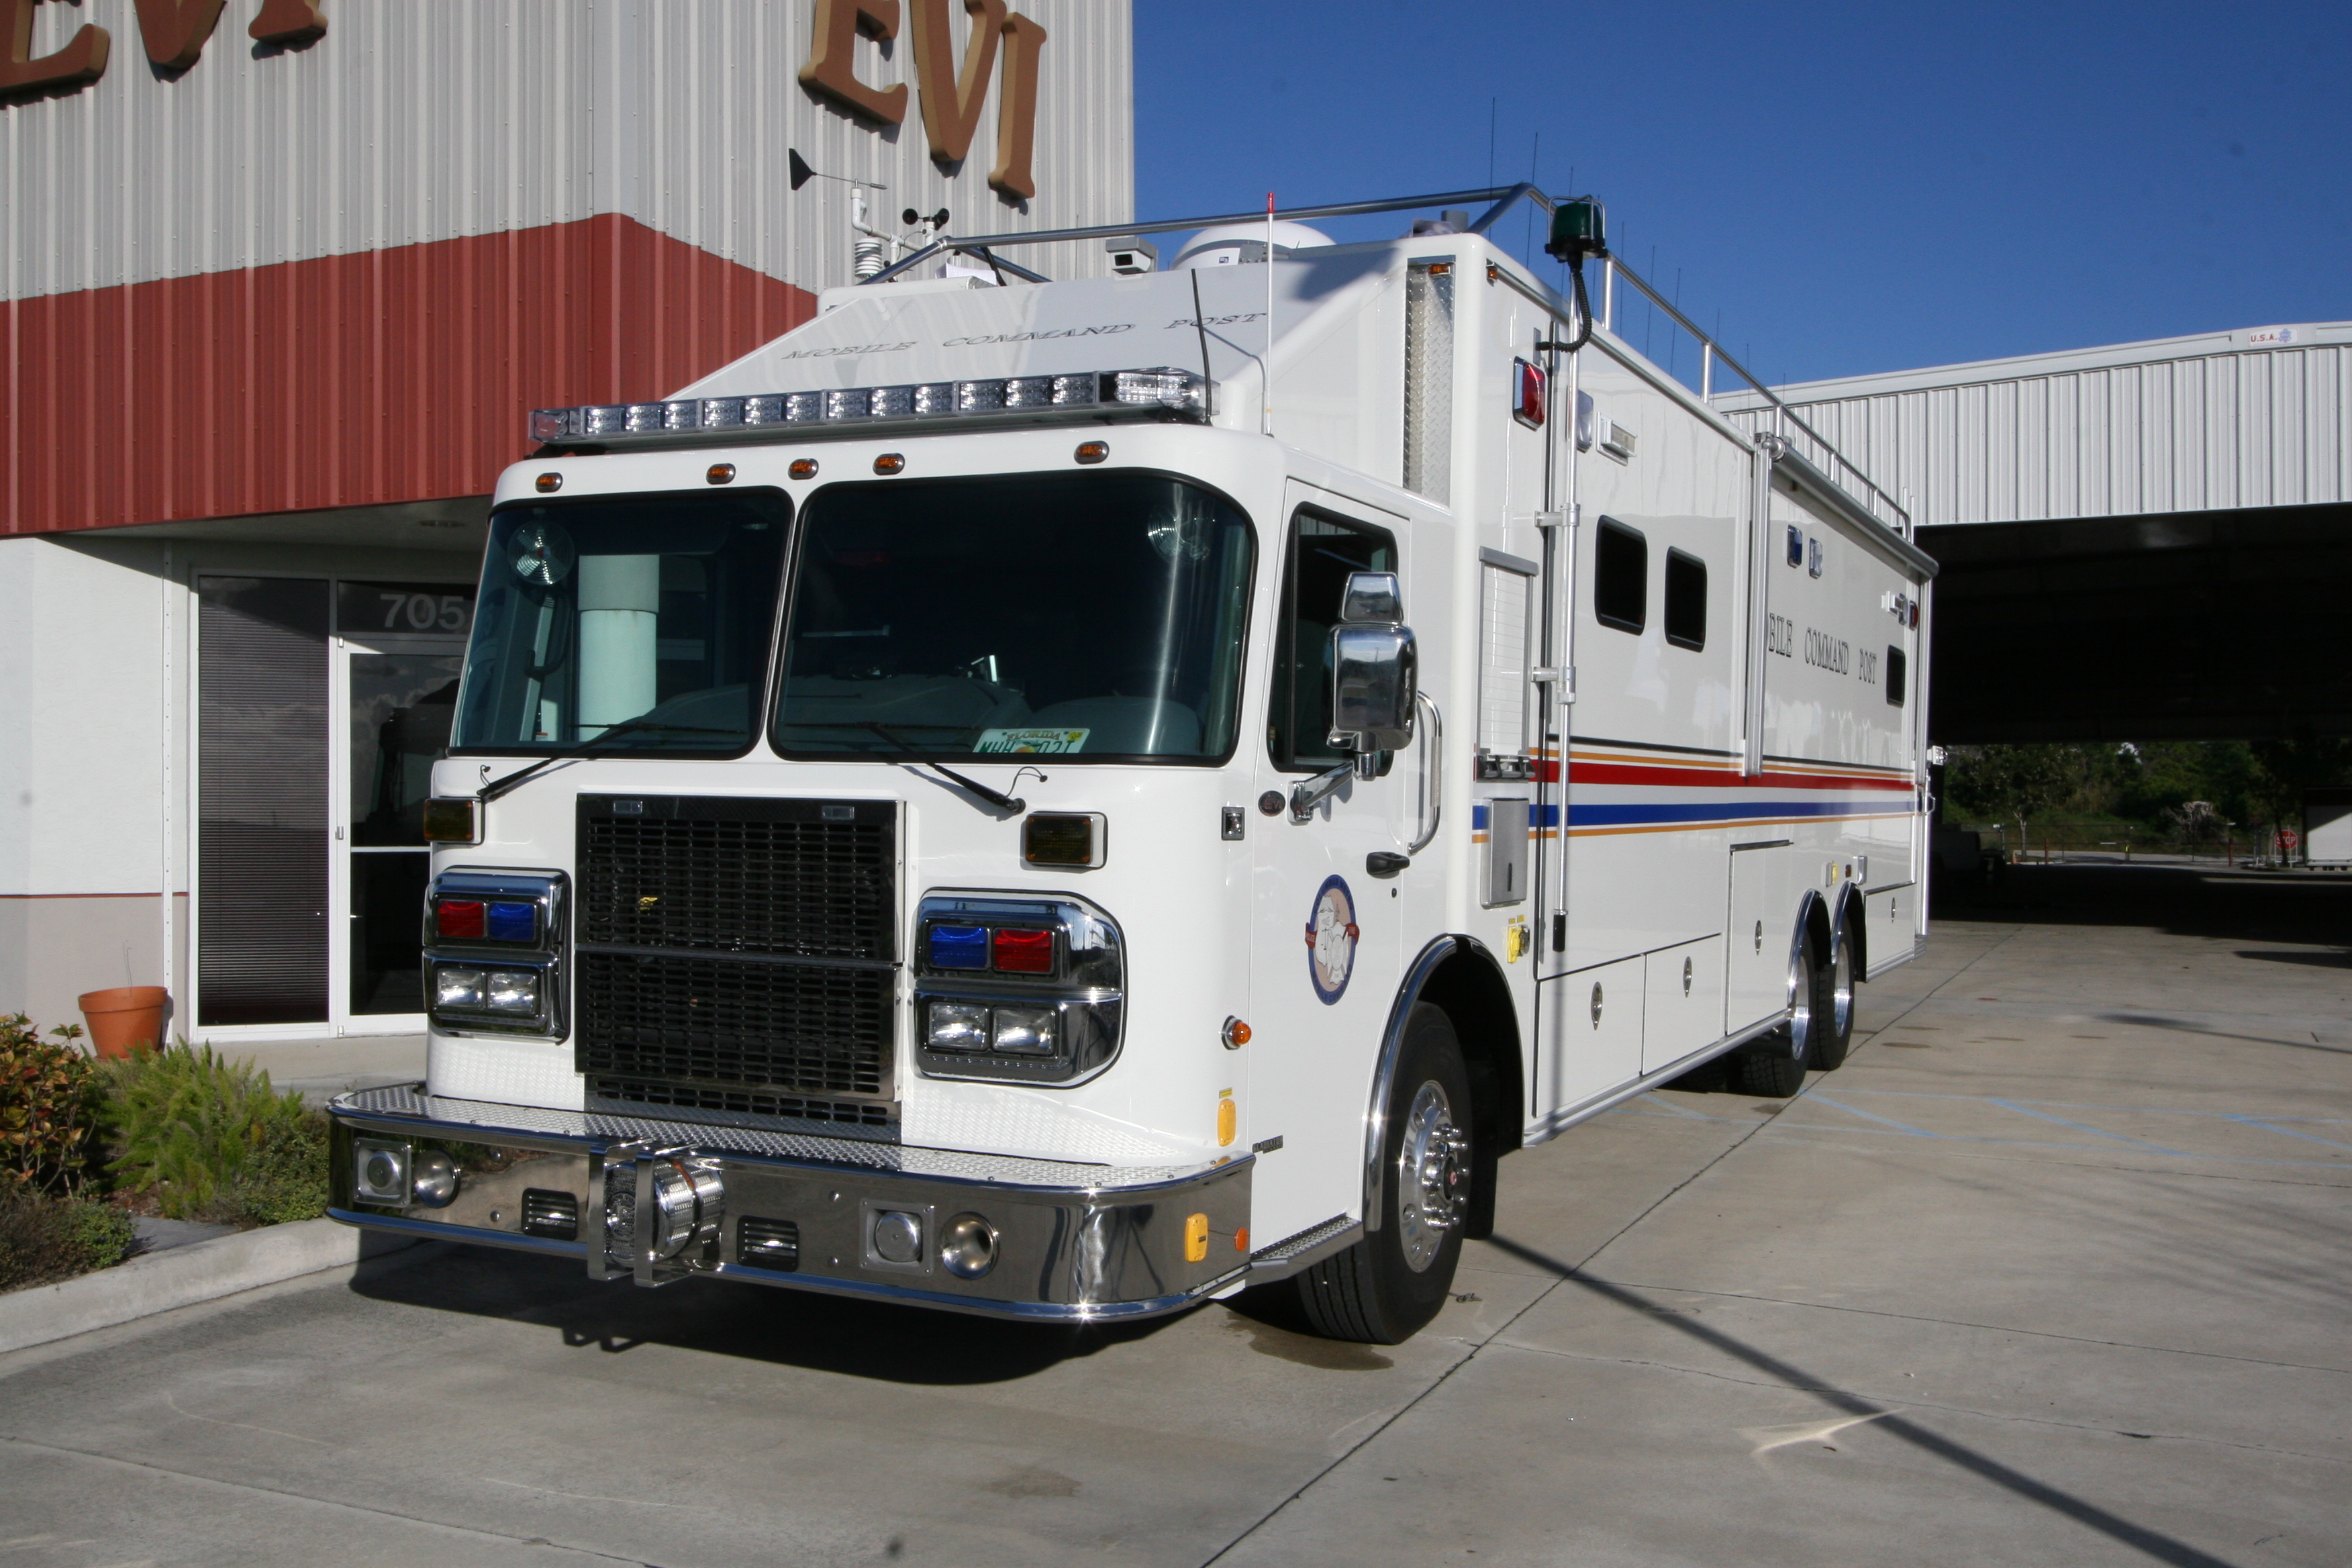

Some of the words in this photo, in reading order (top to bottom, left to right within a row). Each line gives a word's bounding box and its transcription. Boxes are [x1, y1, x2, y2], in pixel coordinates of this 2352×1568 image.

[781, 341, 918, 360] MOBILE
[942, 324, 1136, 346] COMMAND
[1164, 313, 1267, 330] POST
[2250, 334, 2277, 343] U.S.A.
[380, 593, 466, 630] 705
[1804, 627, 1849, 675] COMMAND
[1859, 648, 1877, 684] POST
[1006, 730, 1061, 741] FLORIDA
[2276, 836, 2296, 844] SOP
